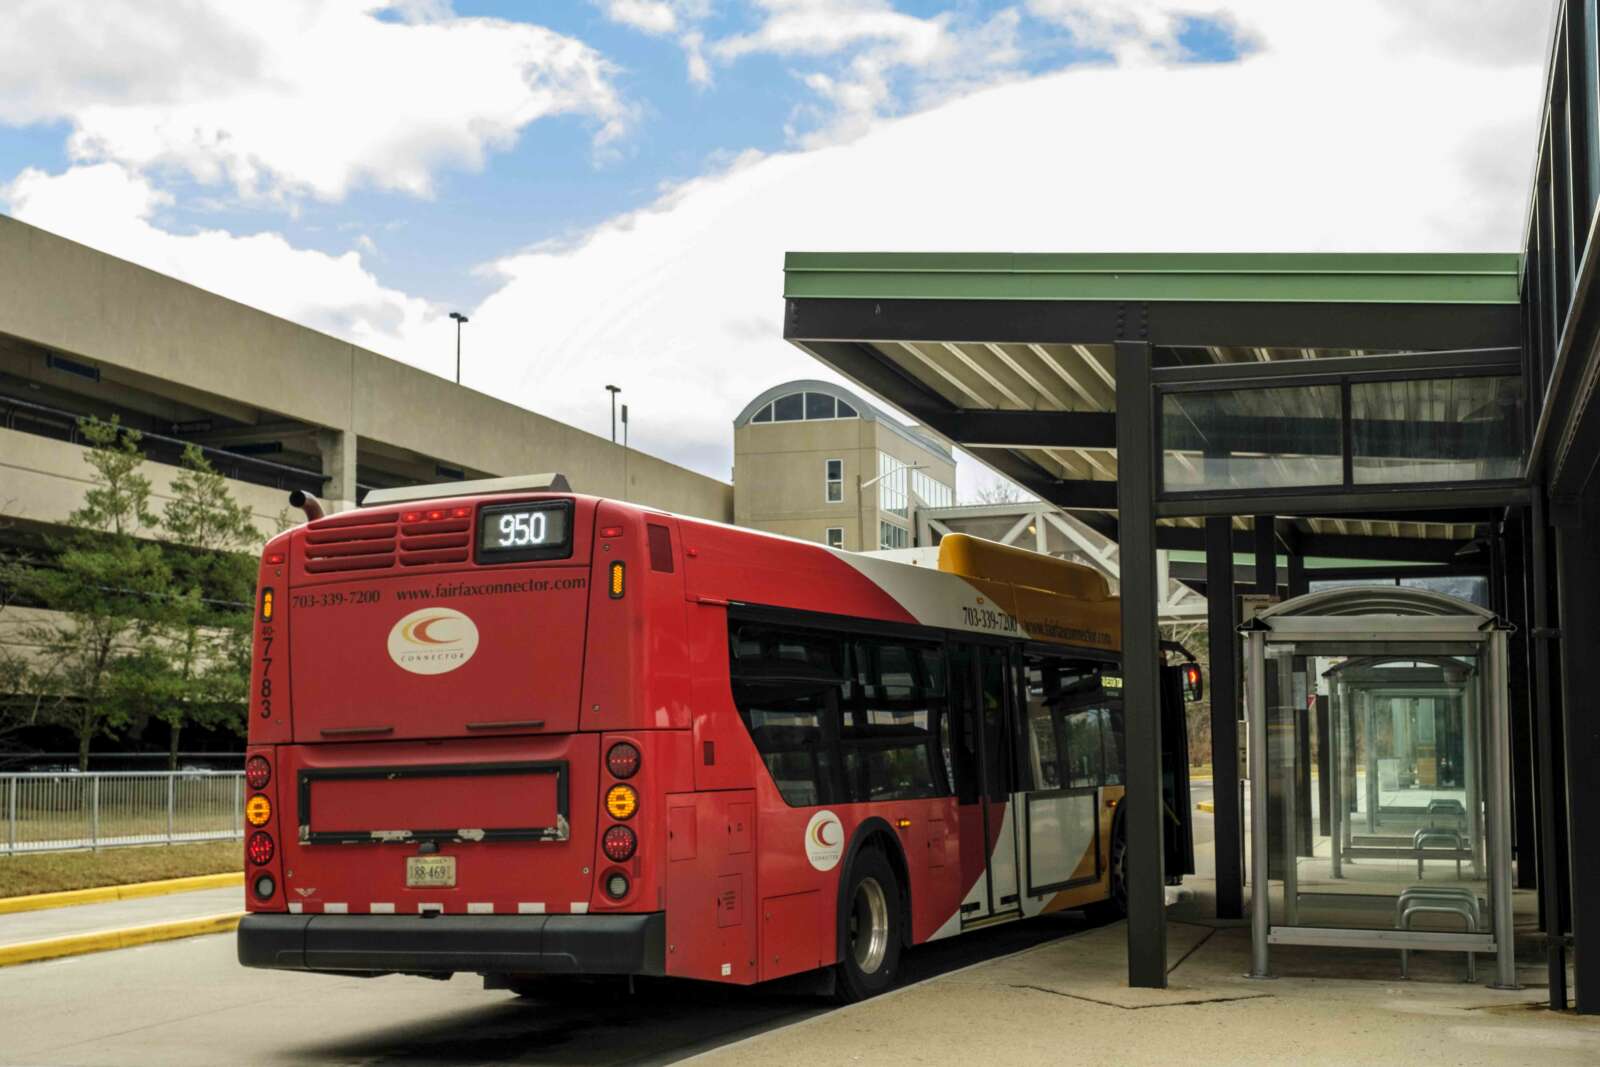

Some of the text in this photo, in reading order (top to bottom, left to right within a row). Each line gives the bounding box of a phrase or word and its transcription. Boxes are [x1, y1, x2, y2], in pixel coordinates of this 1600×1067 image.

[499, 511, 546, 547] 950
[292, 578, 586, 607] 703-339-7200 www.fairfaxconnector.com
[962, 606, 1018, 633] 703-339-7200
[400, 652, 466, 662] CONNECTOR
[260, 636, 273, 719] 7783
